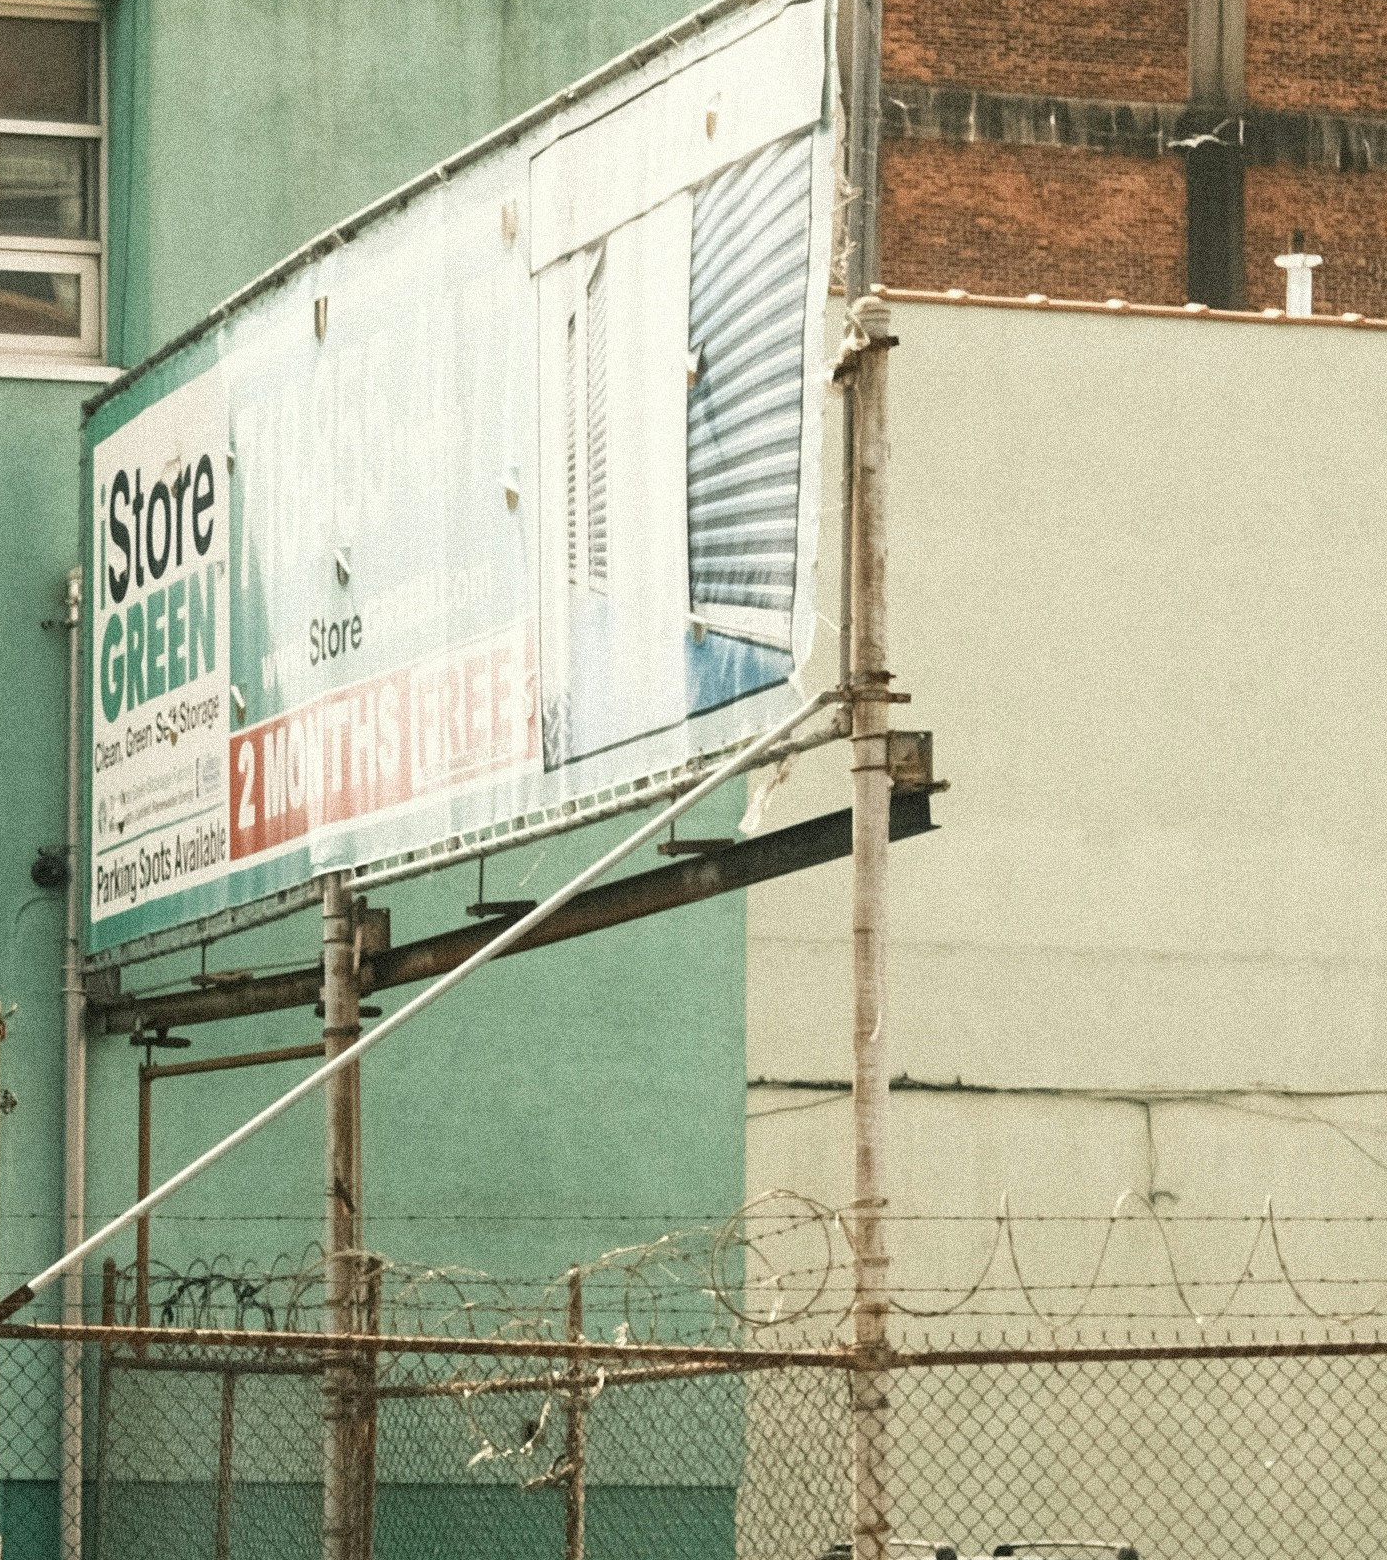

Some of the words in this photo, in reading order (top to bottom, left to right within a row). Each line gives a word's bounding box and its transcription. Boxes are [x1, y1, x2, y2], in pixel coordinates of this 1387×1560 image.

[100, 454, 215, 610] iStore
[100, 562, 216, 723] GREEN
[127, 724, 154, 759] Green
[178, 693, 220, 734] Storage
[237, 740, 257, 830] 2
[262, 680, 402, 824] MONTHS
[417, 647, 511, 768] FREE
[96, 856, 138, 907] Parking
[139, 842, 172, 890] Spots
[175, 818, 227, 878] Available
